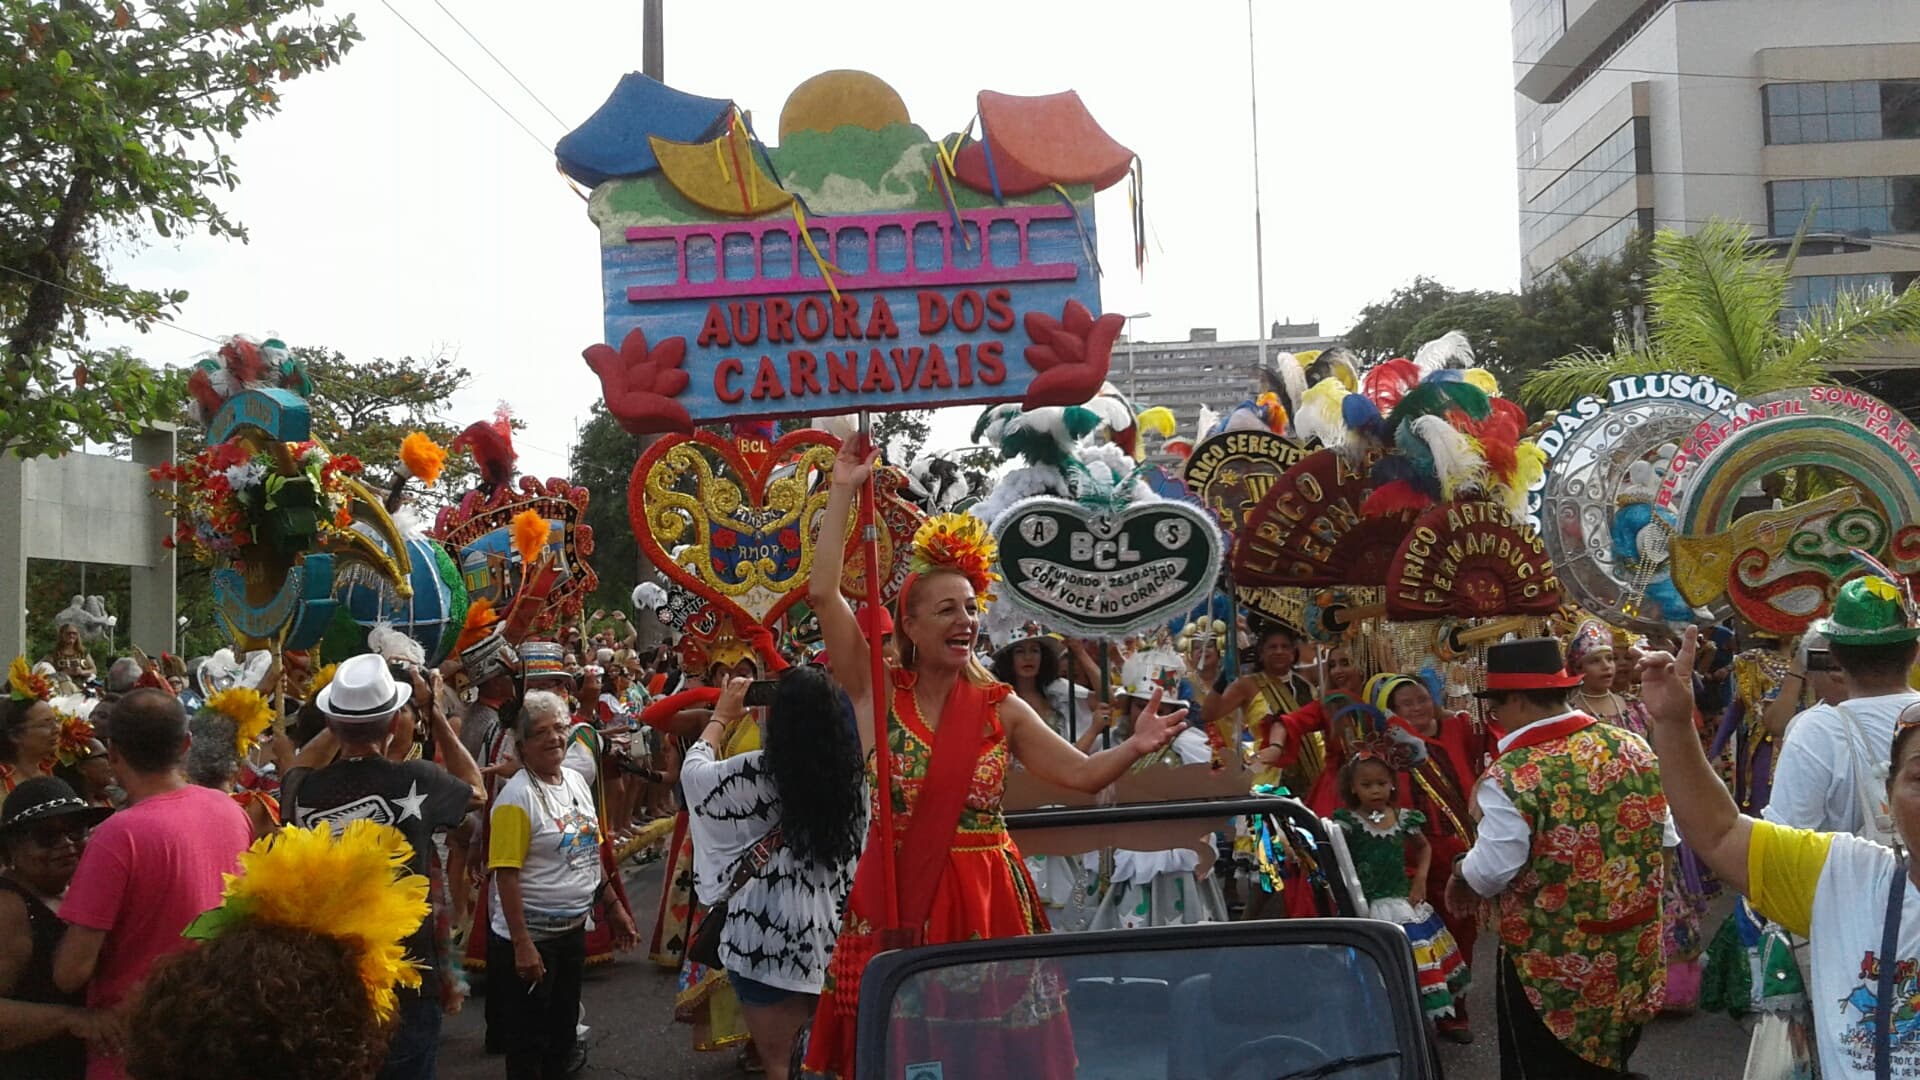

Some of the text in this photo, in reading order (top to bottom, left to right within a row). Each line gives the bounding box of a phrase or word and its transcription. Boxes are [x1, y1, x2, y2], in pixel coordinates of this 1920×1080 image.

[697, 290, 1016, 347] AURORA DOS
[713, 341, 1007, 403] CARNAVAIS
[739, 440, 768, 454] BCL
[1537, 396, 1600, 458] DAS
[1656, 421, 1712, 508] BLOCO
[1695, 400, 1807, 461] INFANTIL
[1809, 387, 1893, 423] SONHO
[1896, 420, 1913, 440] E
[738, 545, 780, 560] AMOR
[1032, 521, 1045, 542] A
[1166, 525, 1179, 544] S
[1031, 566, 1057, 591] COM
[1100, 600, 1119, 614] NO
[1048, 566, 1101, 587] FUNDADO
[1399, 526, 1437, 602] LIRICO
[1539, 559, 1559, 593] DE
[1423, 532, 1540, 604] PERNAMBUCO
